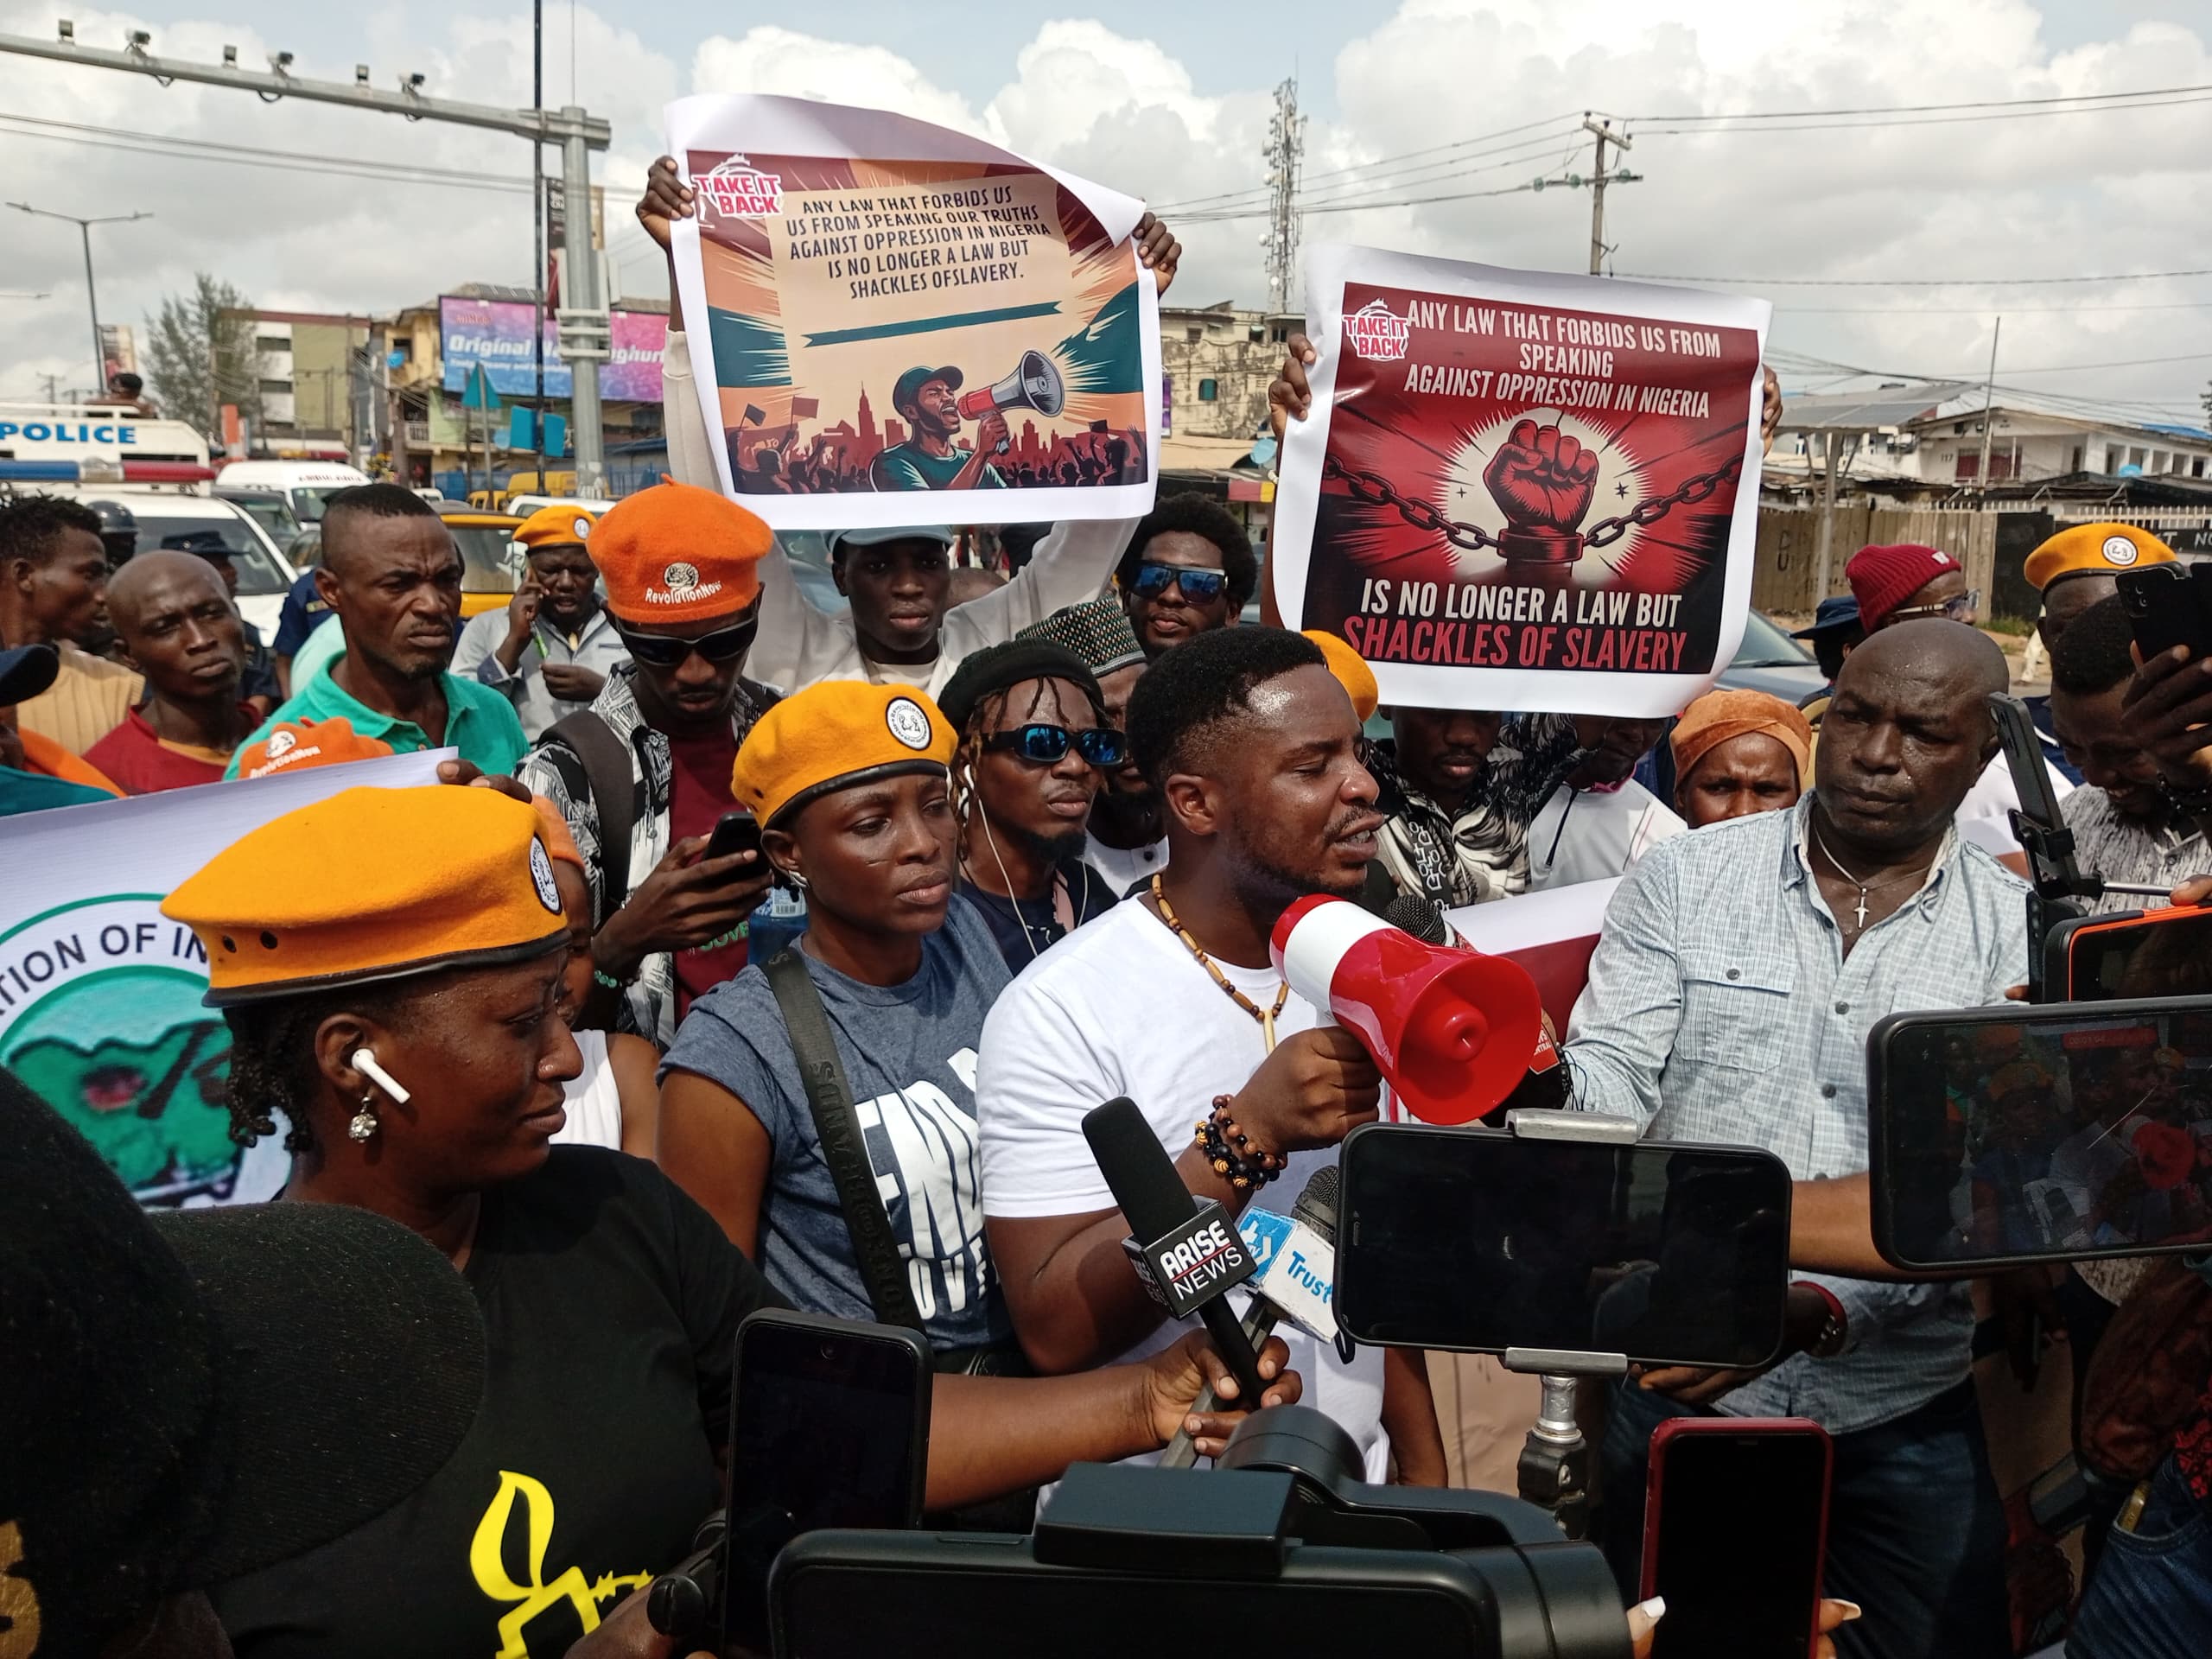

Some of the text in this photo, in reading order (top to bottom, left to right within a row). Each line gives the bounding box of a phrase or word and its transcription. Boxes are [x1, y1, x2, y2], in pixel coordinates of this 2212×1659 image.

[694, 176, 779, 195] TAKE IT
[803, 185, 1012, 214] ANY LAW THAT FORBIDS US
[718, 195, 779, 214] BACK
[786, 204, 1039, 237] US FROM SPEAKING OUR TRUTHS
[790, 223, 1051, 260] AGAINST OPPRESSION IN NIGERIA
[828, 238, 1029, 279] IS NO LONGER A LAW BUT
[850, 272, 927, 300] SHACKLES
[1344, 316, 1408, 337] TAKE IT
[1407, 299, 1721, 359] ANY LAW THAT FORBIDS US FROM
[449, 334, 531, 358] Original
[1358, 336, 1402, 358] BACK
[1519, 342, 1615, 378] SPEAKING
[1403, 363, 1710, 419] AGAINST OPPRESSION IN NIGERIA
[0, 422, 137, 443] POLICE
[1360, 578, 1682, 628] IS NO LONGER A LAW BUT
[1343, 615, 1688, 671] SHACKLES OF SLAVERY
[0, 933, 86, 1015] TION
[100, 923, 157, 956] OF
[1160, 1219, 1230, 1280] ARISE
[1172, 1246, 1243, 1300] NEWS
[1287, 1250, 1333, 1304] Trust
